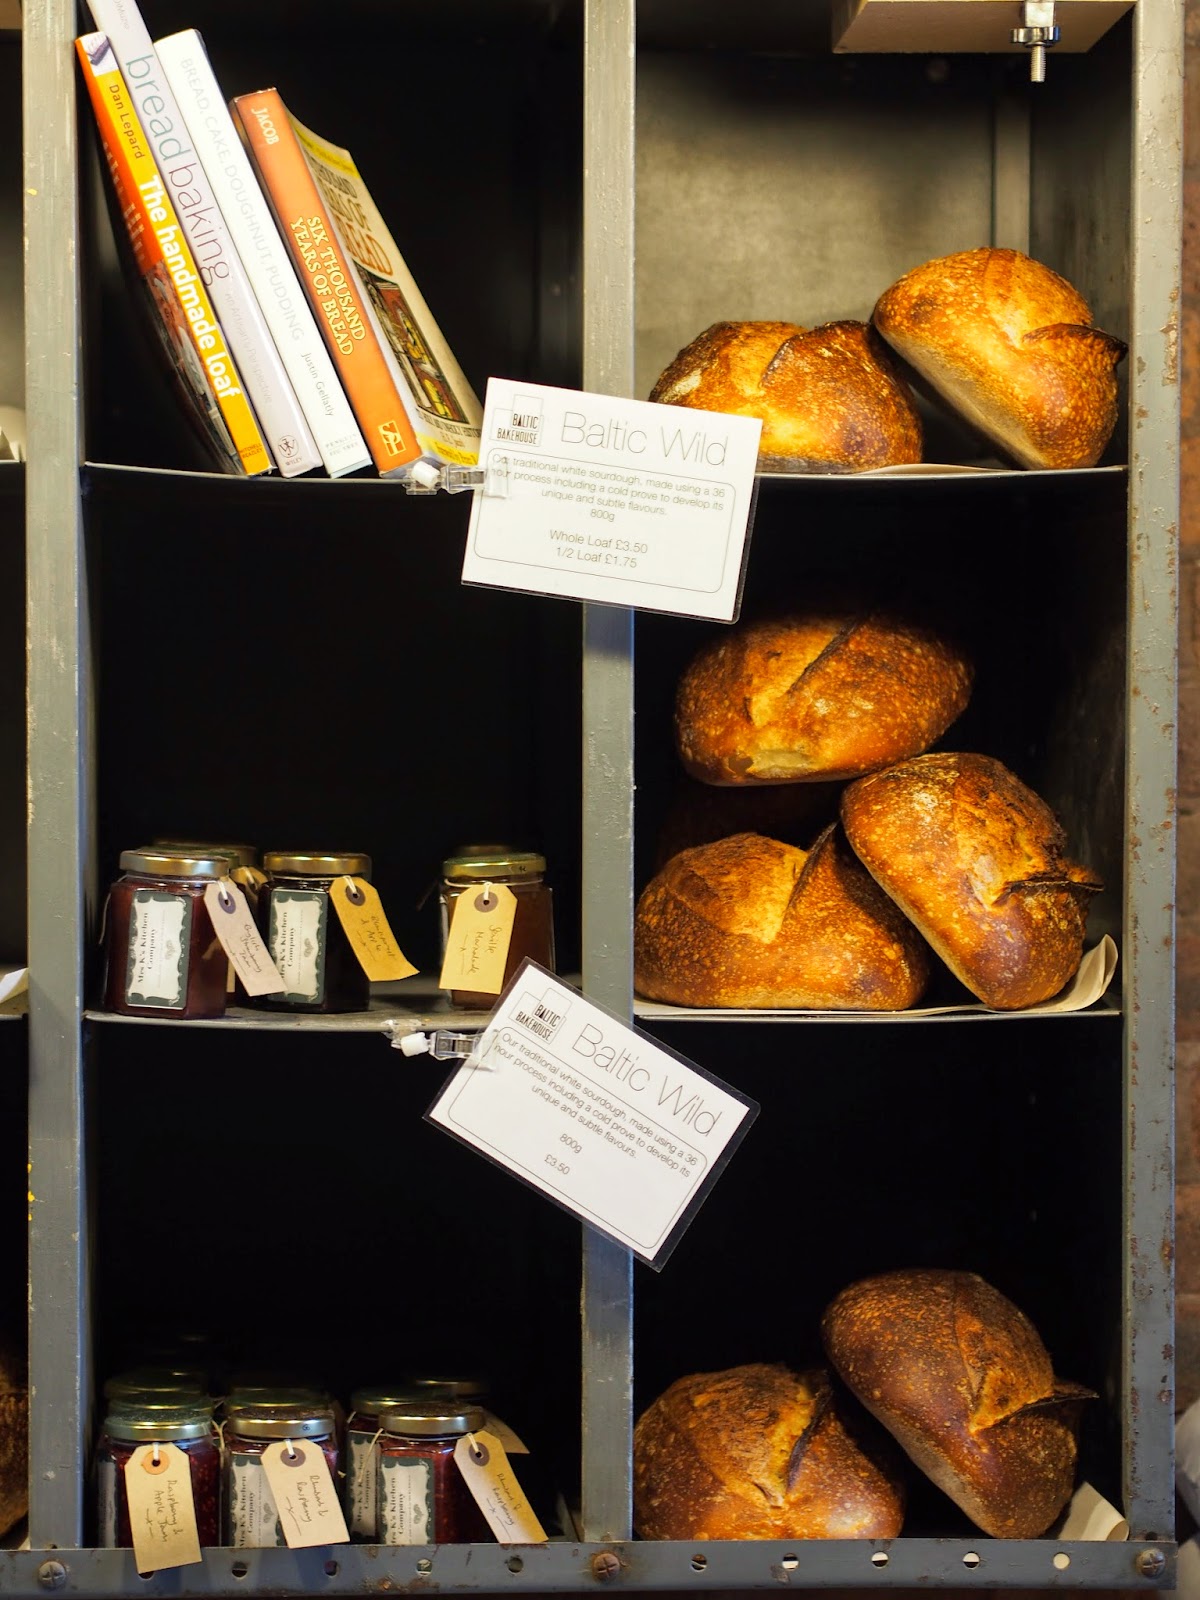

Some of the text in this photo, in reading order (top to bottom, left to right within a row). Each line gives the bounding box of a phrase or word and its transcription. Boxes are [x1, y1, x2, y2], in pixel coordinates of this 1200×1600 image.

[109, 85, 145, 159] Dan Lepard
[251, 107, 280, 145] JACOB
[126, 54, 192, 161] bread
[169, 163, 229, 287] baking
[139, 174, 241, 399] The handmade loaf
[290, 216, 354, 356] YEARS OF BREAD
[306, 216, 329, 246] SIX
[320, 246, 366, 341] THOUSAND
[265, 265, 305, 342] PUDDING
[301, 352, 335, 417] Justin Gellatly
[497, 427, 538, 445] BAKEHOUSE
[512, 413, 539, 430] BALTIC
[561, 411, 729, 466] Baltic Wild
[512, 458, 559, 472] traditional
[562, 466, 586, 476] white
[646, 479, 673, 490] made
[675, 483, 701, 496] using
[712, 487, 725, 498] 36
[513, 472, 551, 485] process
[554, 477, 597, 493] including
[607, 486, 628, 496] cold
[630, 489, 658, 501] prove
[660, 494, 670, 503] to
[672, 495, 710, 509] develop
[713, 502, 724, 511] its
[541, 489, 668, 515] unique and subtle flavours.
[590, 508, 615, 522] 800g
[549, 529, 648, 554] Whole Loaf £3.50
[556, 547, 637, 568] 1/2 Loaf £1.75
[140, 912, 148, 947] Kitchen
[147, 929, 158, 970] Company
[287, 927, 296, 967] Company
[485, 924, 502, 954] Seville
[515, 1011, 553, 1041] BAKEHOUSE
[534, 1004, 561, 1027] BALTIC
[502, 1033, 698, 1166] Our traditional white sourdough, made using a 36
[572, 1023, 723, 1137] Baltic Wild
[513, 1058, 548, 1083] process
[548, 1078, 585, 1109] including
[585, 1104, 592, 1112] a
[592, 1109, 612, 1125] cold
[611, 1121, 636, 1141] prove
[636, 1137, 645, 1147] to
[646, 1144, 680, 1170] develop
[679, 1165, 691, 1178] its
[531, 1085, 637, 1159] unique and subtle flavours.
[559, 1133, 582, 1154] 800g
[544, 1154, 570, 1175] £3.50
[154, 1490, 169, 1542] Apple Jam
[247, 1492, 255, 1533] Company
[296, 1481, 312, 1523] Raspberry
[492, 1487, 515, 1526] Raspberry
